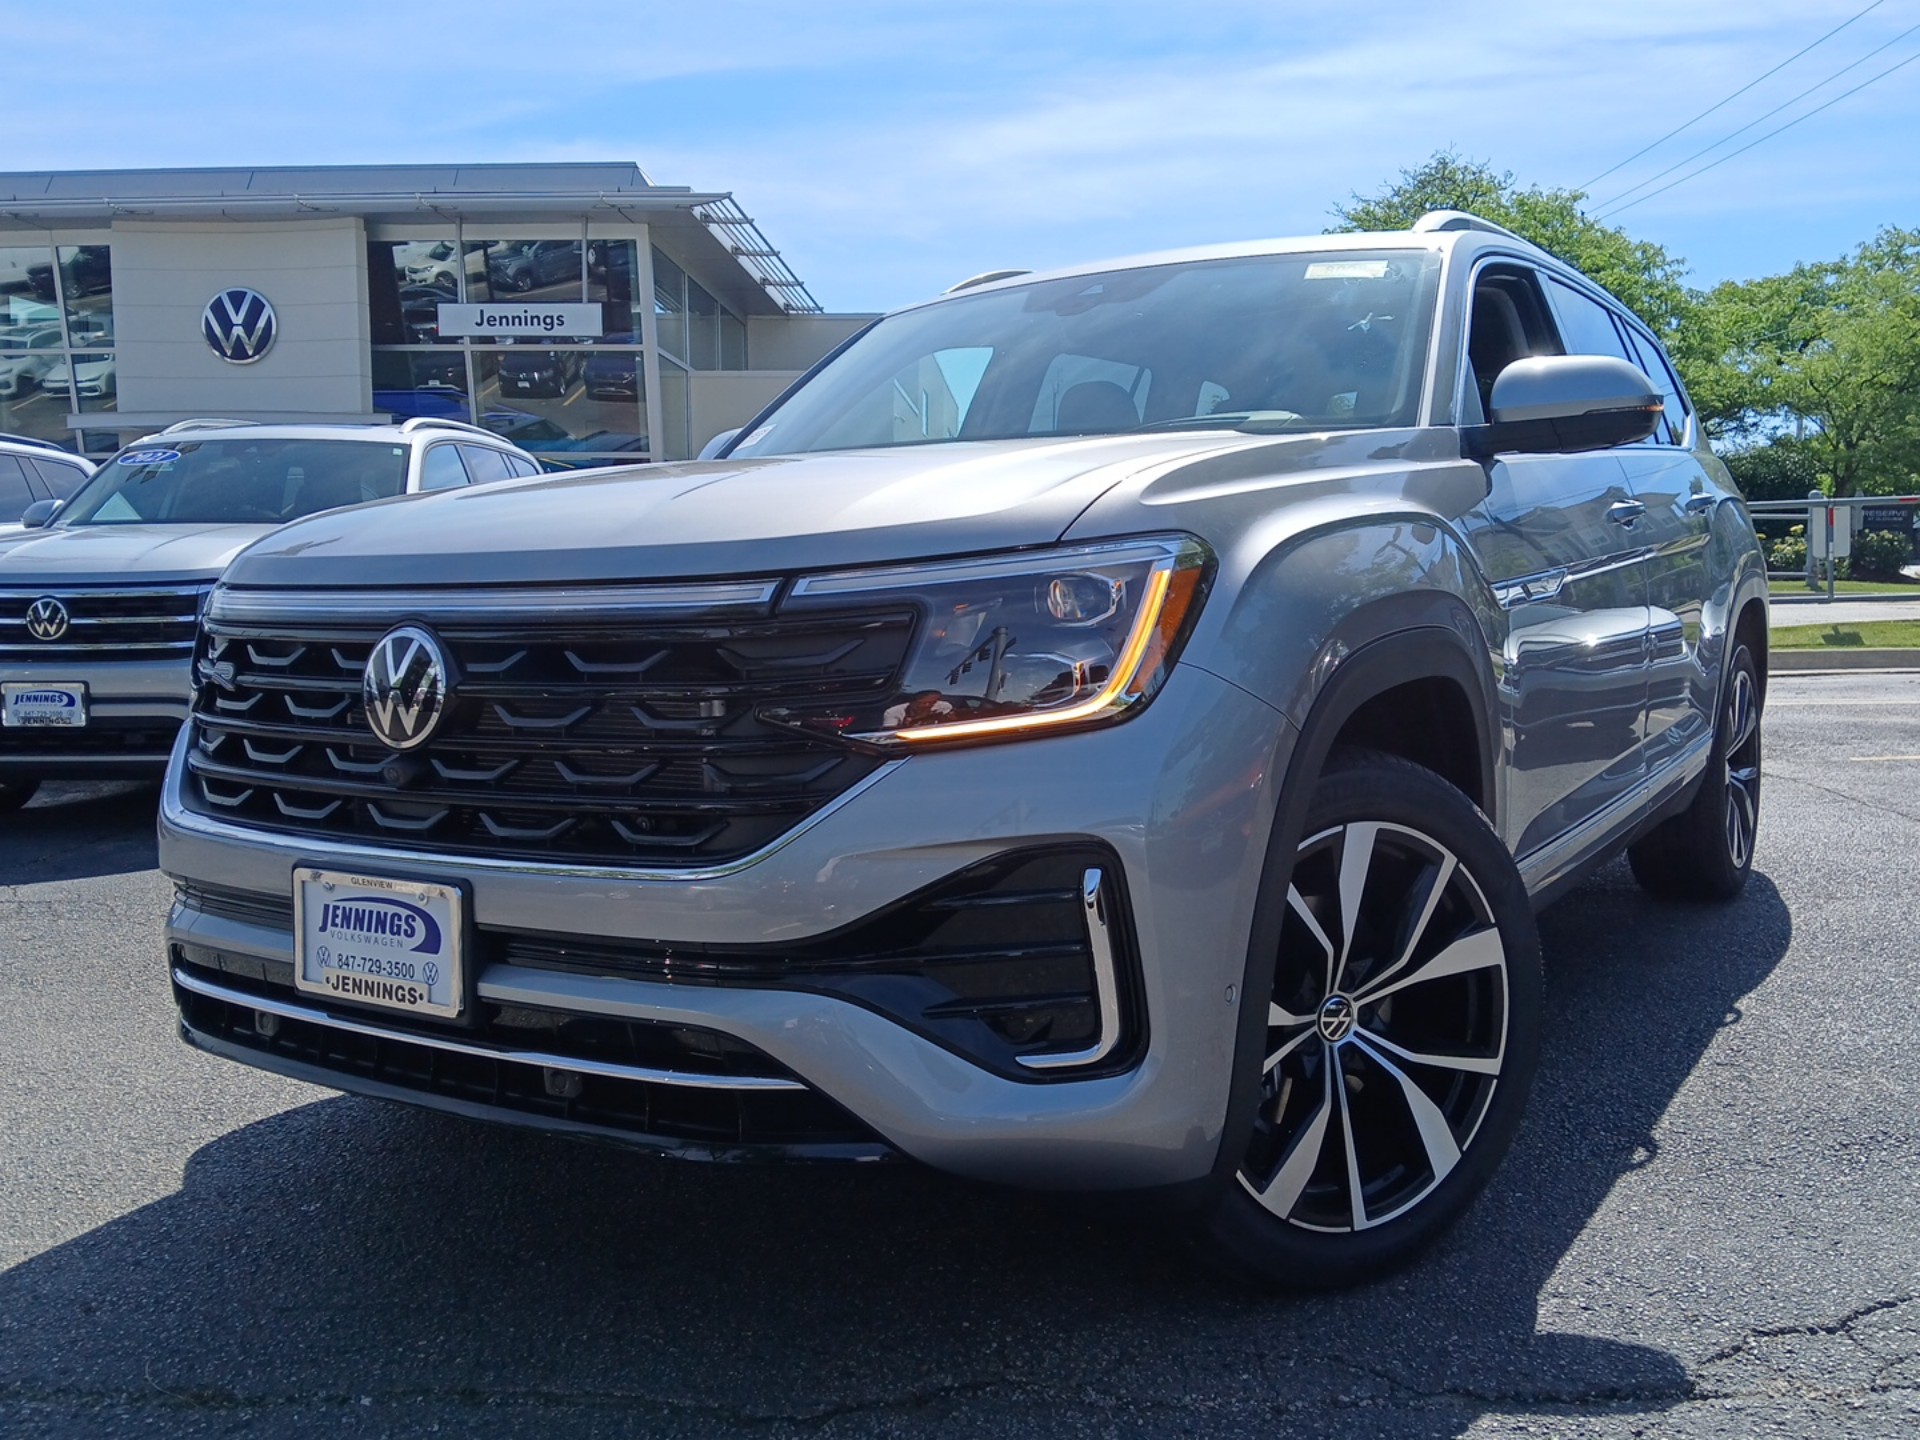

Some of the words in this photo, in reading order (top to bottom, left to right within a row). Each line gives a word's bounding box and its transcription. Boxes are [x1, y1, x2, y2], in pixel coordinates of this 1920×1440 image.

[201, 287, 277, 364] VW
[474, 309, 565, 331] Jennings
[1863, 509, 1908, 517] RESERVE
[27, 598, 68, 640] VW
[13, 694, 64, 705] JENNINGS
[364, 627, 446, 749] VW
[351, 877, 393, 890] GLENVIEW
[319, 903, 417, 938] JENNINGS
[330, 929, 404, 948] VOLKSWAGEN
[337, 953, 415, 979] 847-729-3500
